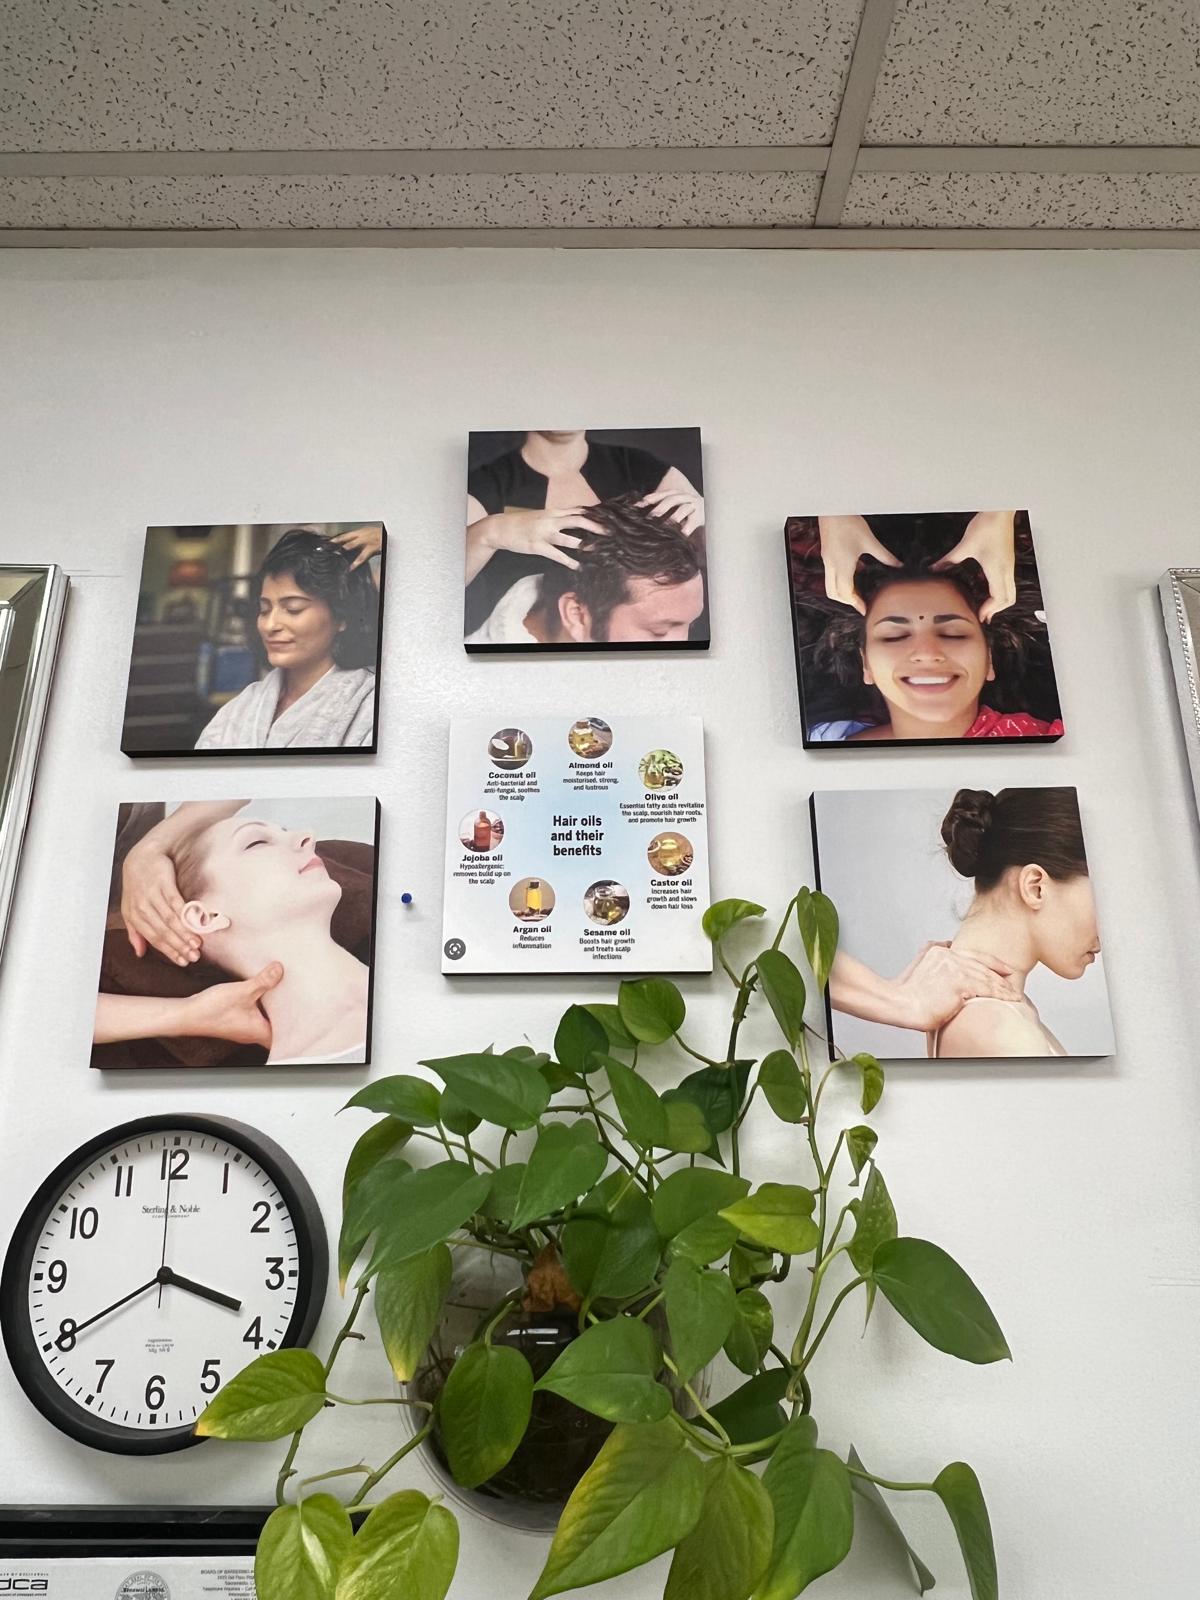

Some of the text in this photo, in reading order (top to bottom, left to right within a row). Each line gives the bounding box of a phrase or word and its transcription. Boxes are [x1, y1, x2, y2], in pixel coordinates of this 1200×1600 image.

[551, 830, 604, 841] and their
[553, 815, 602, 826] Hair oils
[462, 855, 490, 863] Jojoba
[553, 845, 602, 856] benefits
[513, 926, 538, 934] Argan
[160, 1148, 190, 1181] 12
[222, 1162, 229, 1194] 1
[114, 1165, 134, 1197] 11
[69, 1207, 99, 1240] 10
[170, 1205, 176, 1213] &
[178, 1204, 200, 1213] Noble
[250, 1201, 272, 1233] 2
[46, 1259, 68, 1293] 9
[264, 1257, 285, 1290] 3
[55, 1318, 77, 1352] 8
[242, 1316, 264, 1350] 4
[94, 1359, 115, 1393] 7
[200, 1359, 221, 1394] 5
[145, 1375, 166, 1410] 6
